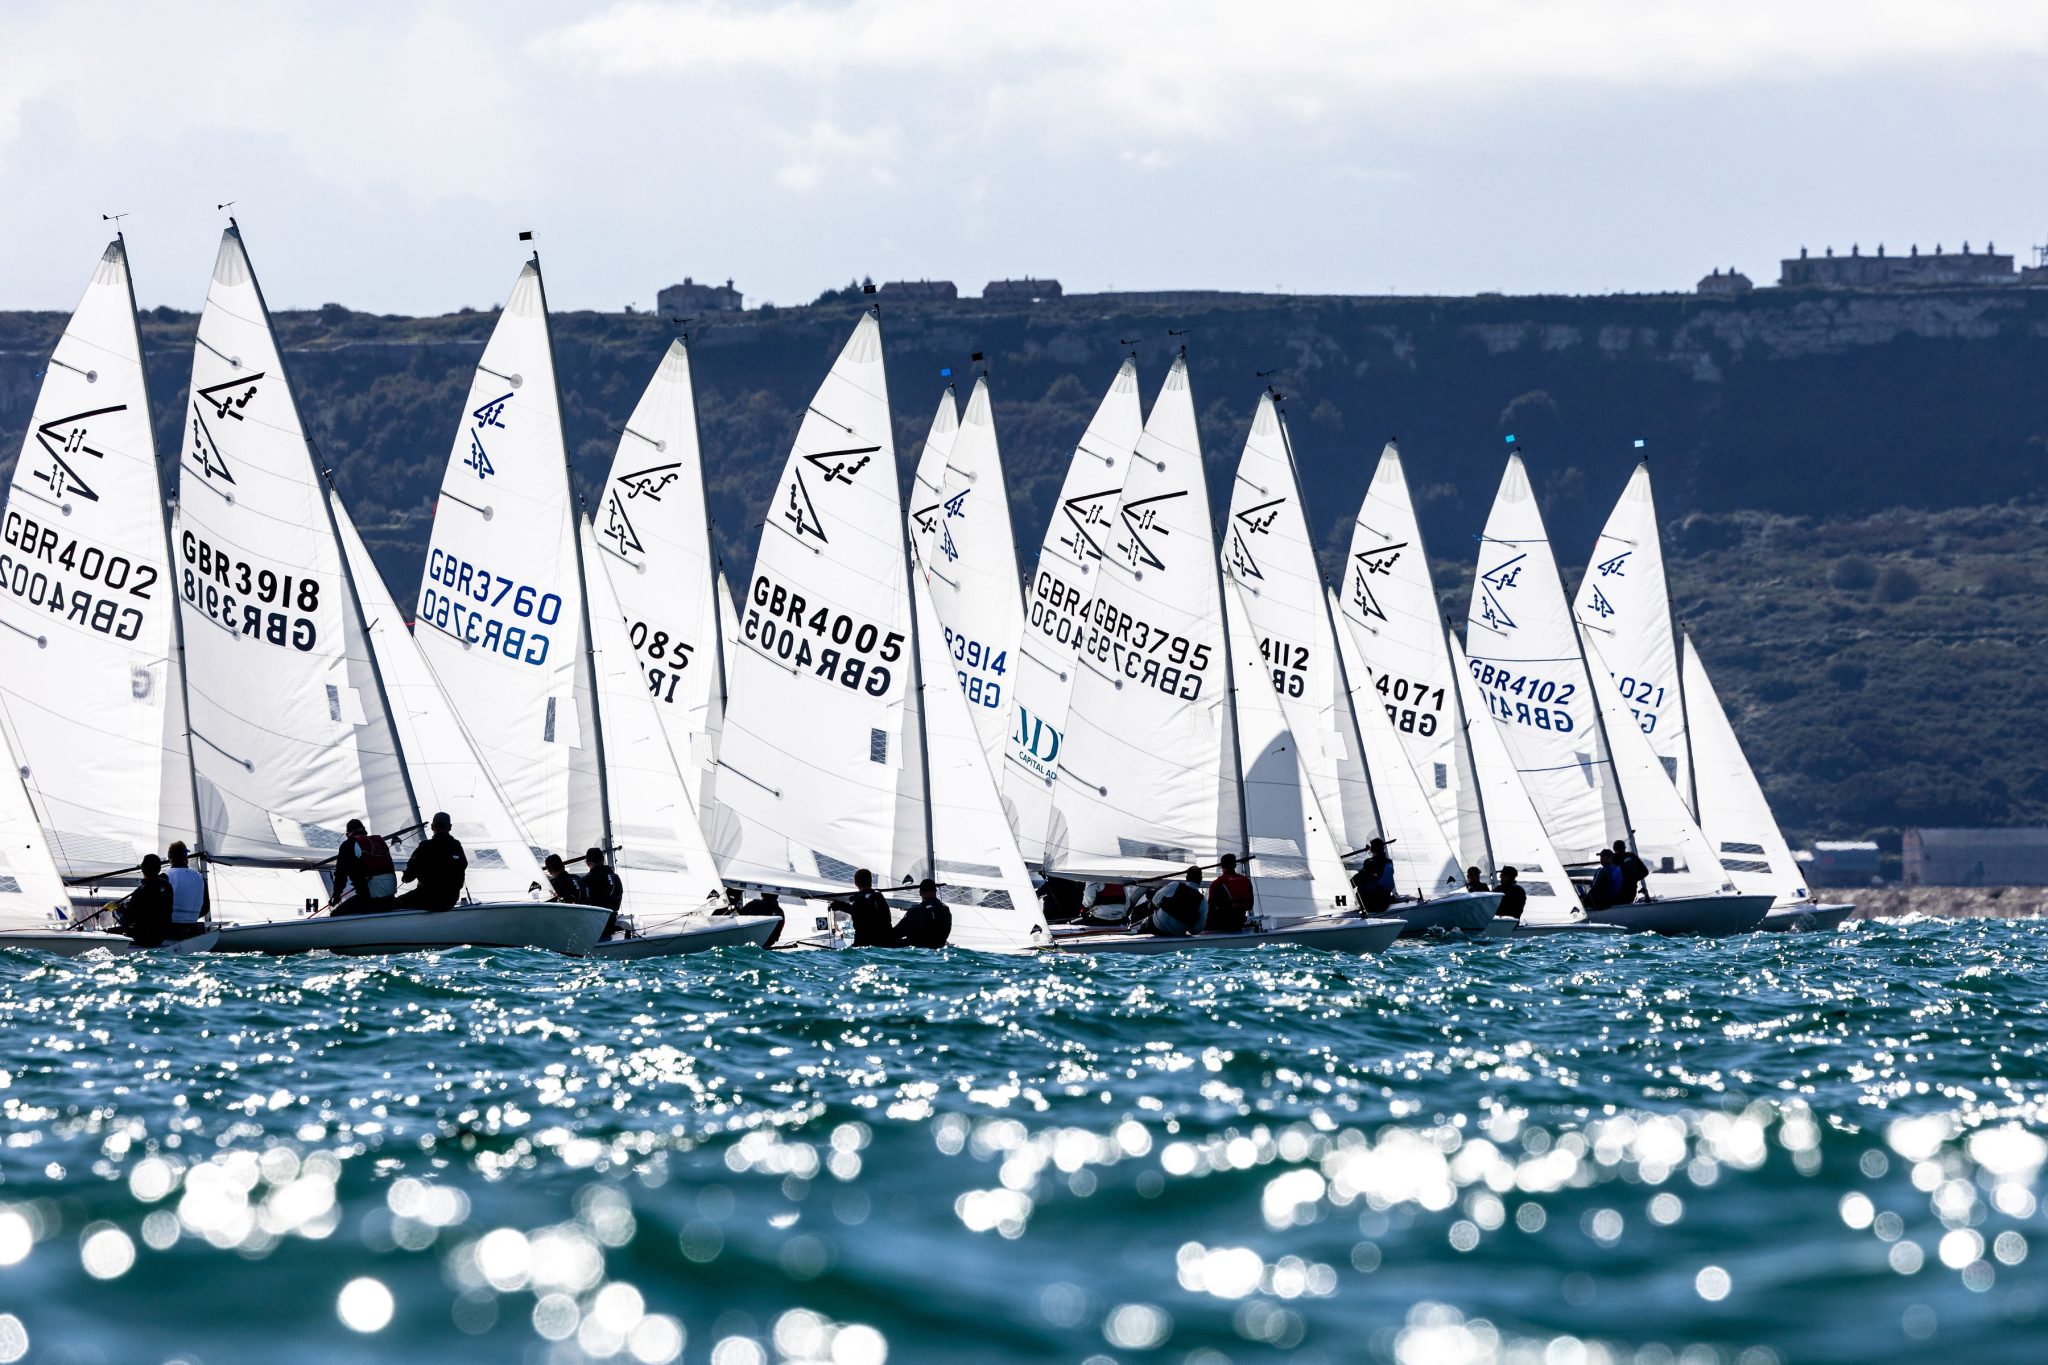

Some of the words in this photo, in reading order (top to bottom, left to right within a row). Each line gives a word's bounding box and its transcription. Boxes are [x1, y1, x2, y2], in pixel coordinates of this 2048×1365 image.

[5, 512, 157, 599] GBR4002
[183, 530, 319, 612] GBR3918
[430, 548, 561, 625] GBR3760
[623, 616, 695, 669] 085
[754, 575, 905, 662] GBR4005
[1094, 598, 1211, 670] GBR3795
[1259, 637, 1309, 671] 4112
[1367, 666, 1445, 711] 4071
[1469, 659, 1575, 705] GBR4102
[1610, 672, 1665, 707] 021
[1012, 704, 1064, 762] MD
[1018, 751, 1045, 774] CAPITAL
